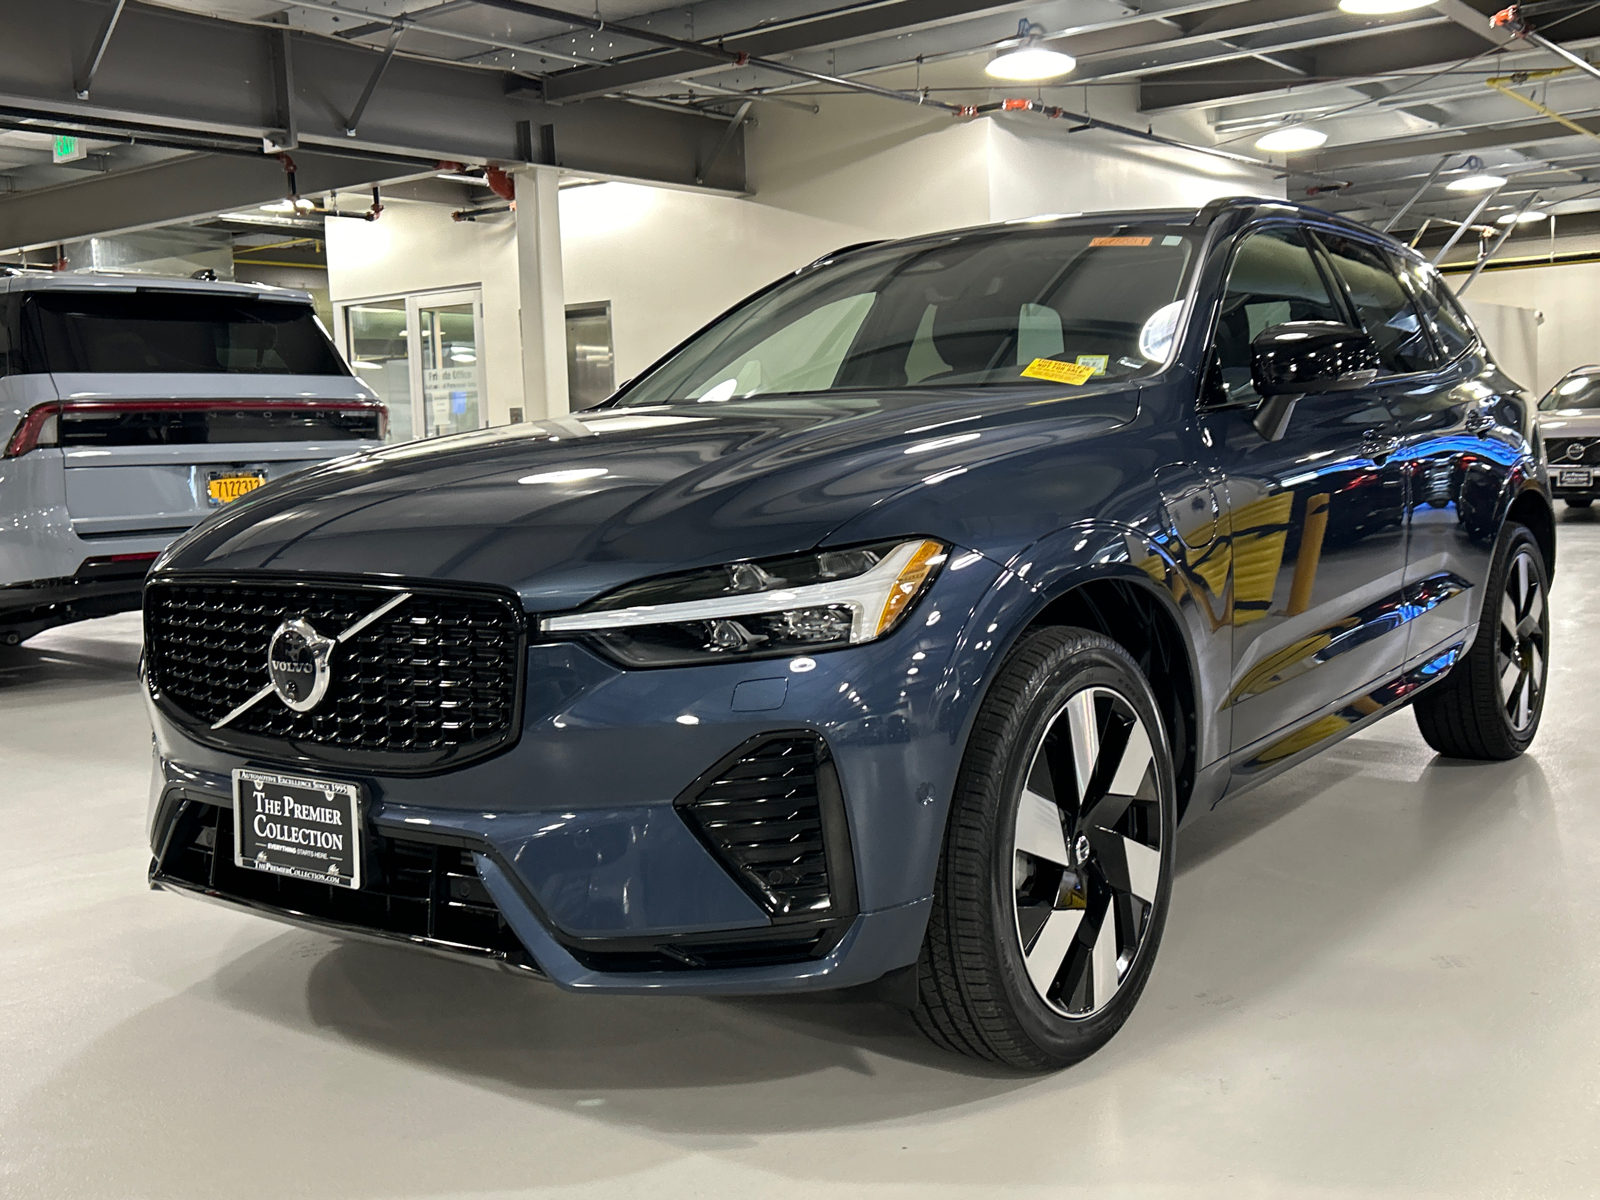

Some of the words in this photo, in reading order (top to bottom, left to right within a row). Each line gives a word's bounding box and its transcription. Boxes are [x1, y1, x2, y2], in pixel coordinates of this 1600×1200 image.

[142, 410, 325, 421] LINCOLN
[271, 661, 313, 673] VOLVO
[331, 783, 348, 795] 1995
[253, 814, 343, 851] COLLECTION
[267, 842, 297, 855] EVERYTHING
[297, 848, 314, 858] STARTS
